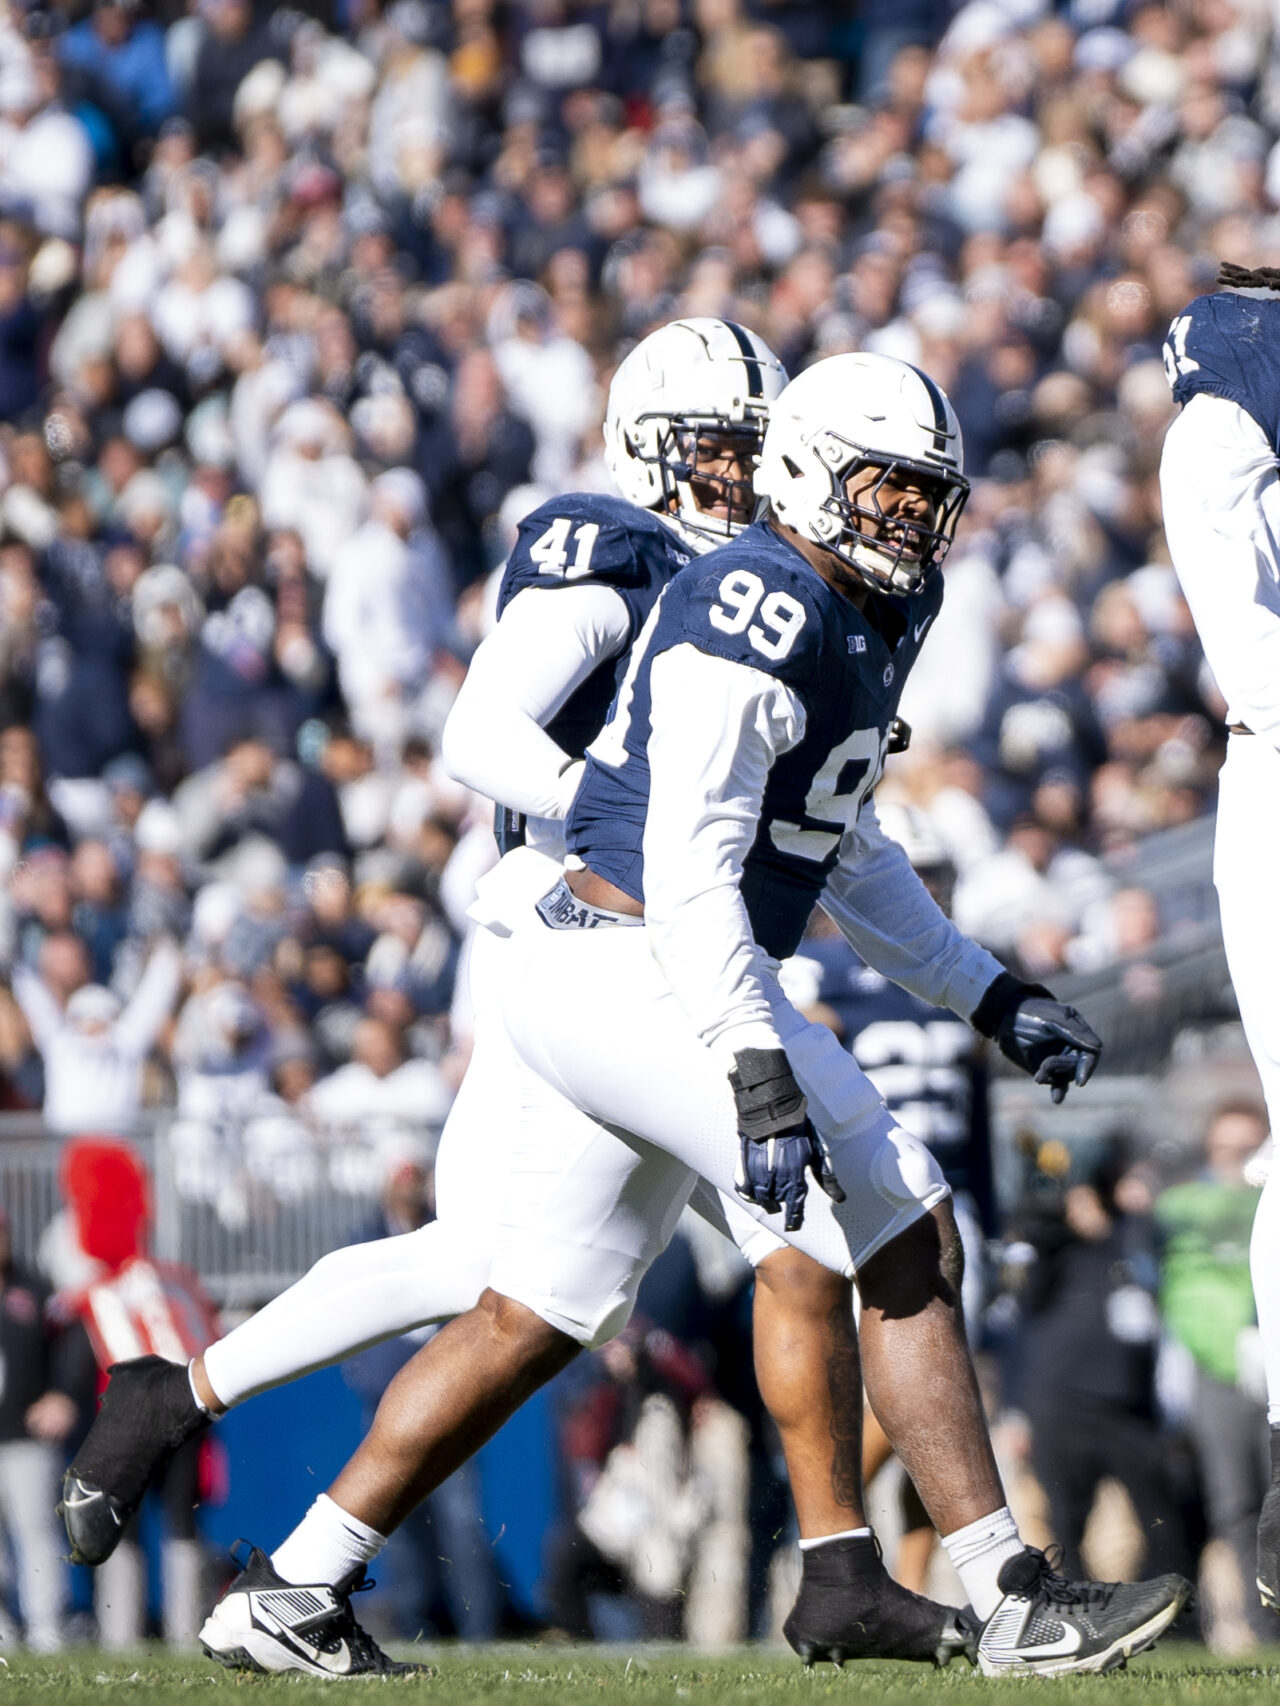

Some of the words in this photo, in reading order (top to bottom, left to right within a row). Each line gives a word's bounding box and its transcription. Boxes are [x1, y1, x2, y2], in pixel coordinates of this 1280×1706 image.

[529, 518, 600, 580] 41
[708, 569, 807, 661] 99
[768, 711, 897, 863] 9
